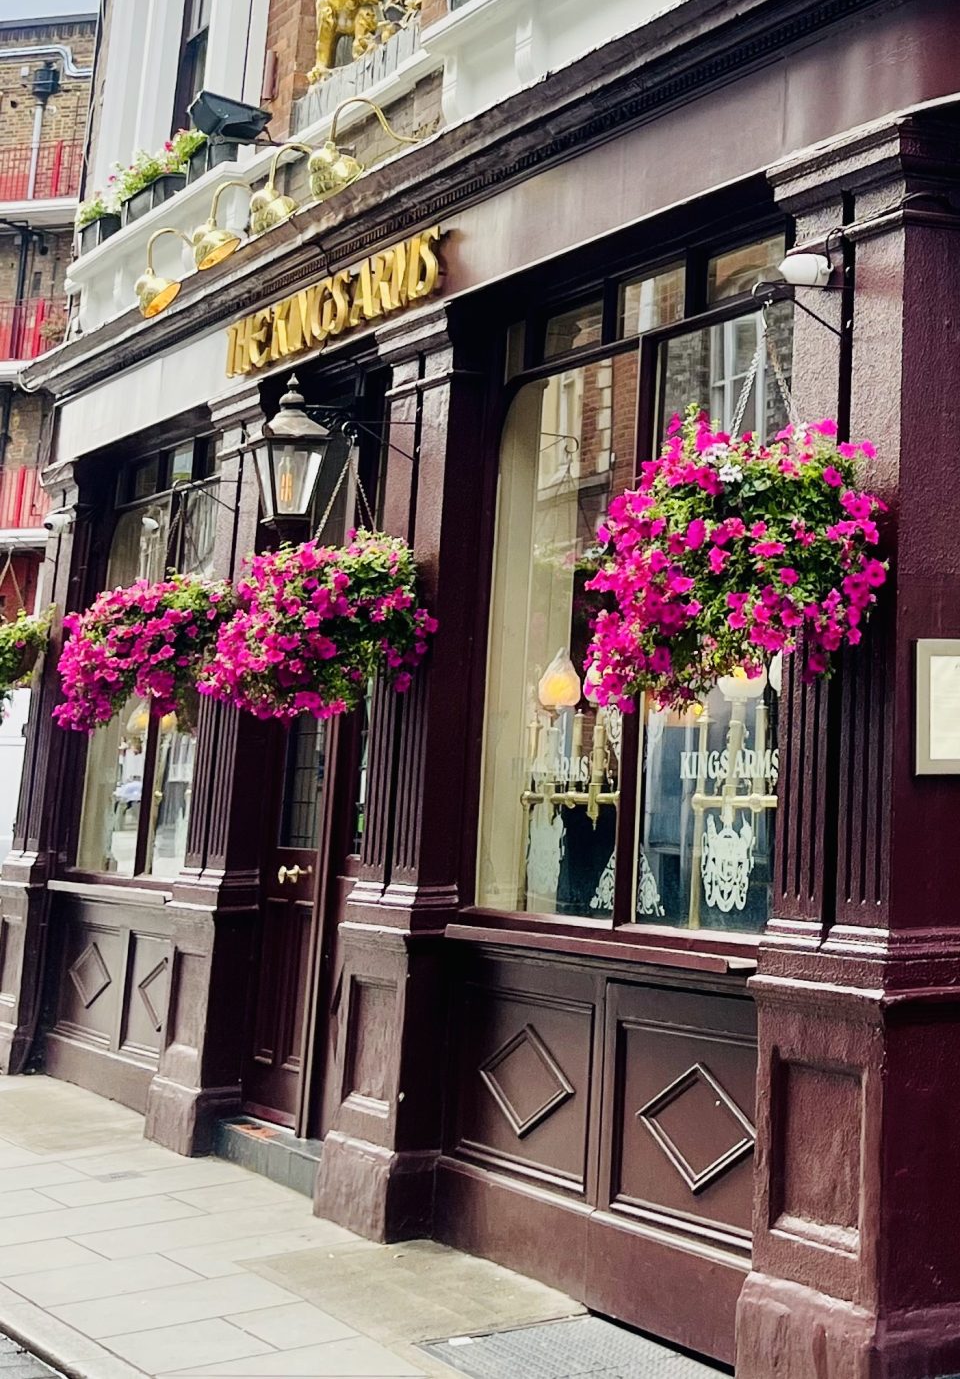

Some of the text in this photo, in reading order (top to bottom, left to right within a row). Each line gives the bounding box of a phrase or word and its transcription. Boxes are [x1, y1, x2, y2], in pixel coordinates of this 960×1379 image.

[226, 305, 275, 379] THE
[349, 225, 441, 327] ARMS
[680, 749, 729, 779] KINGS
